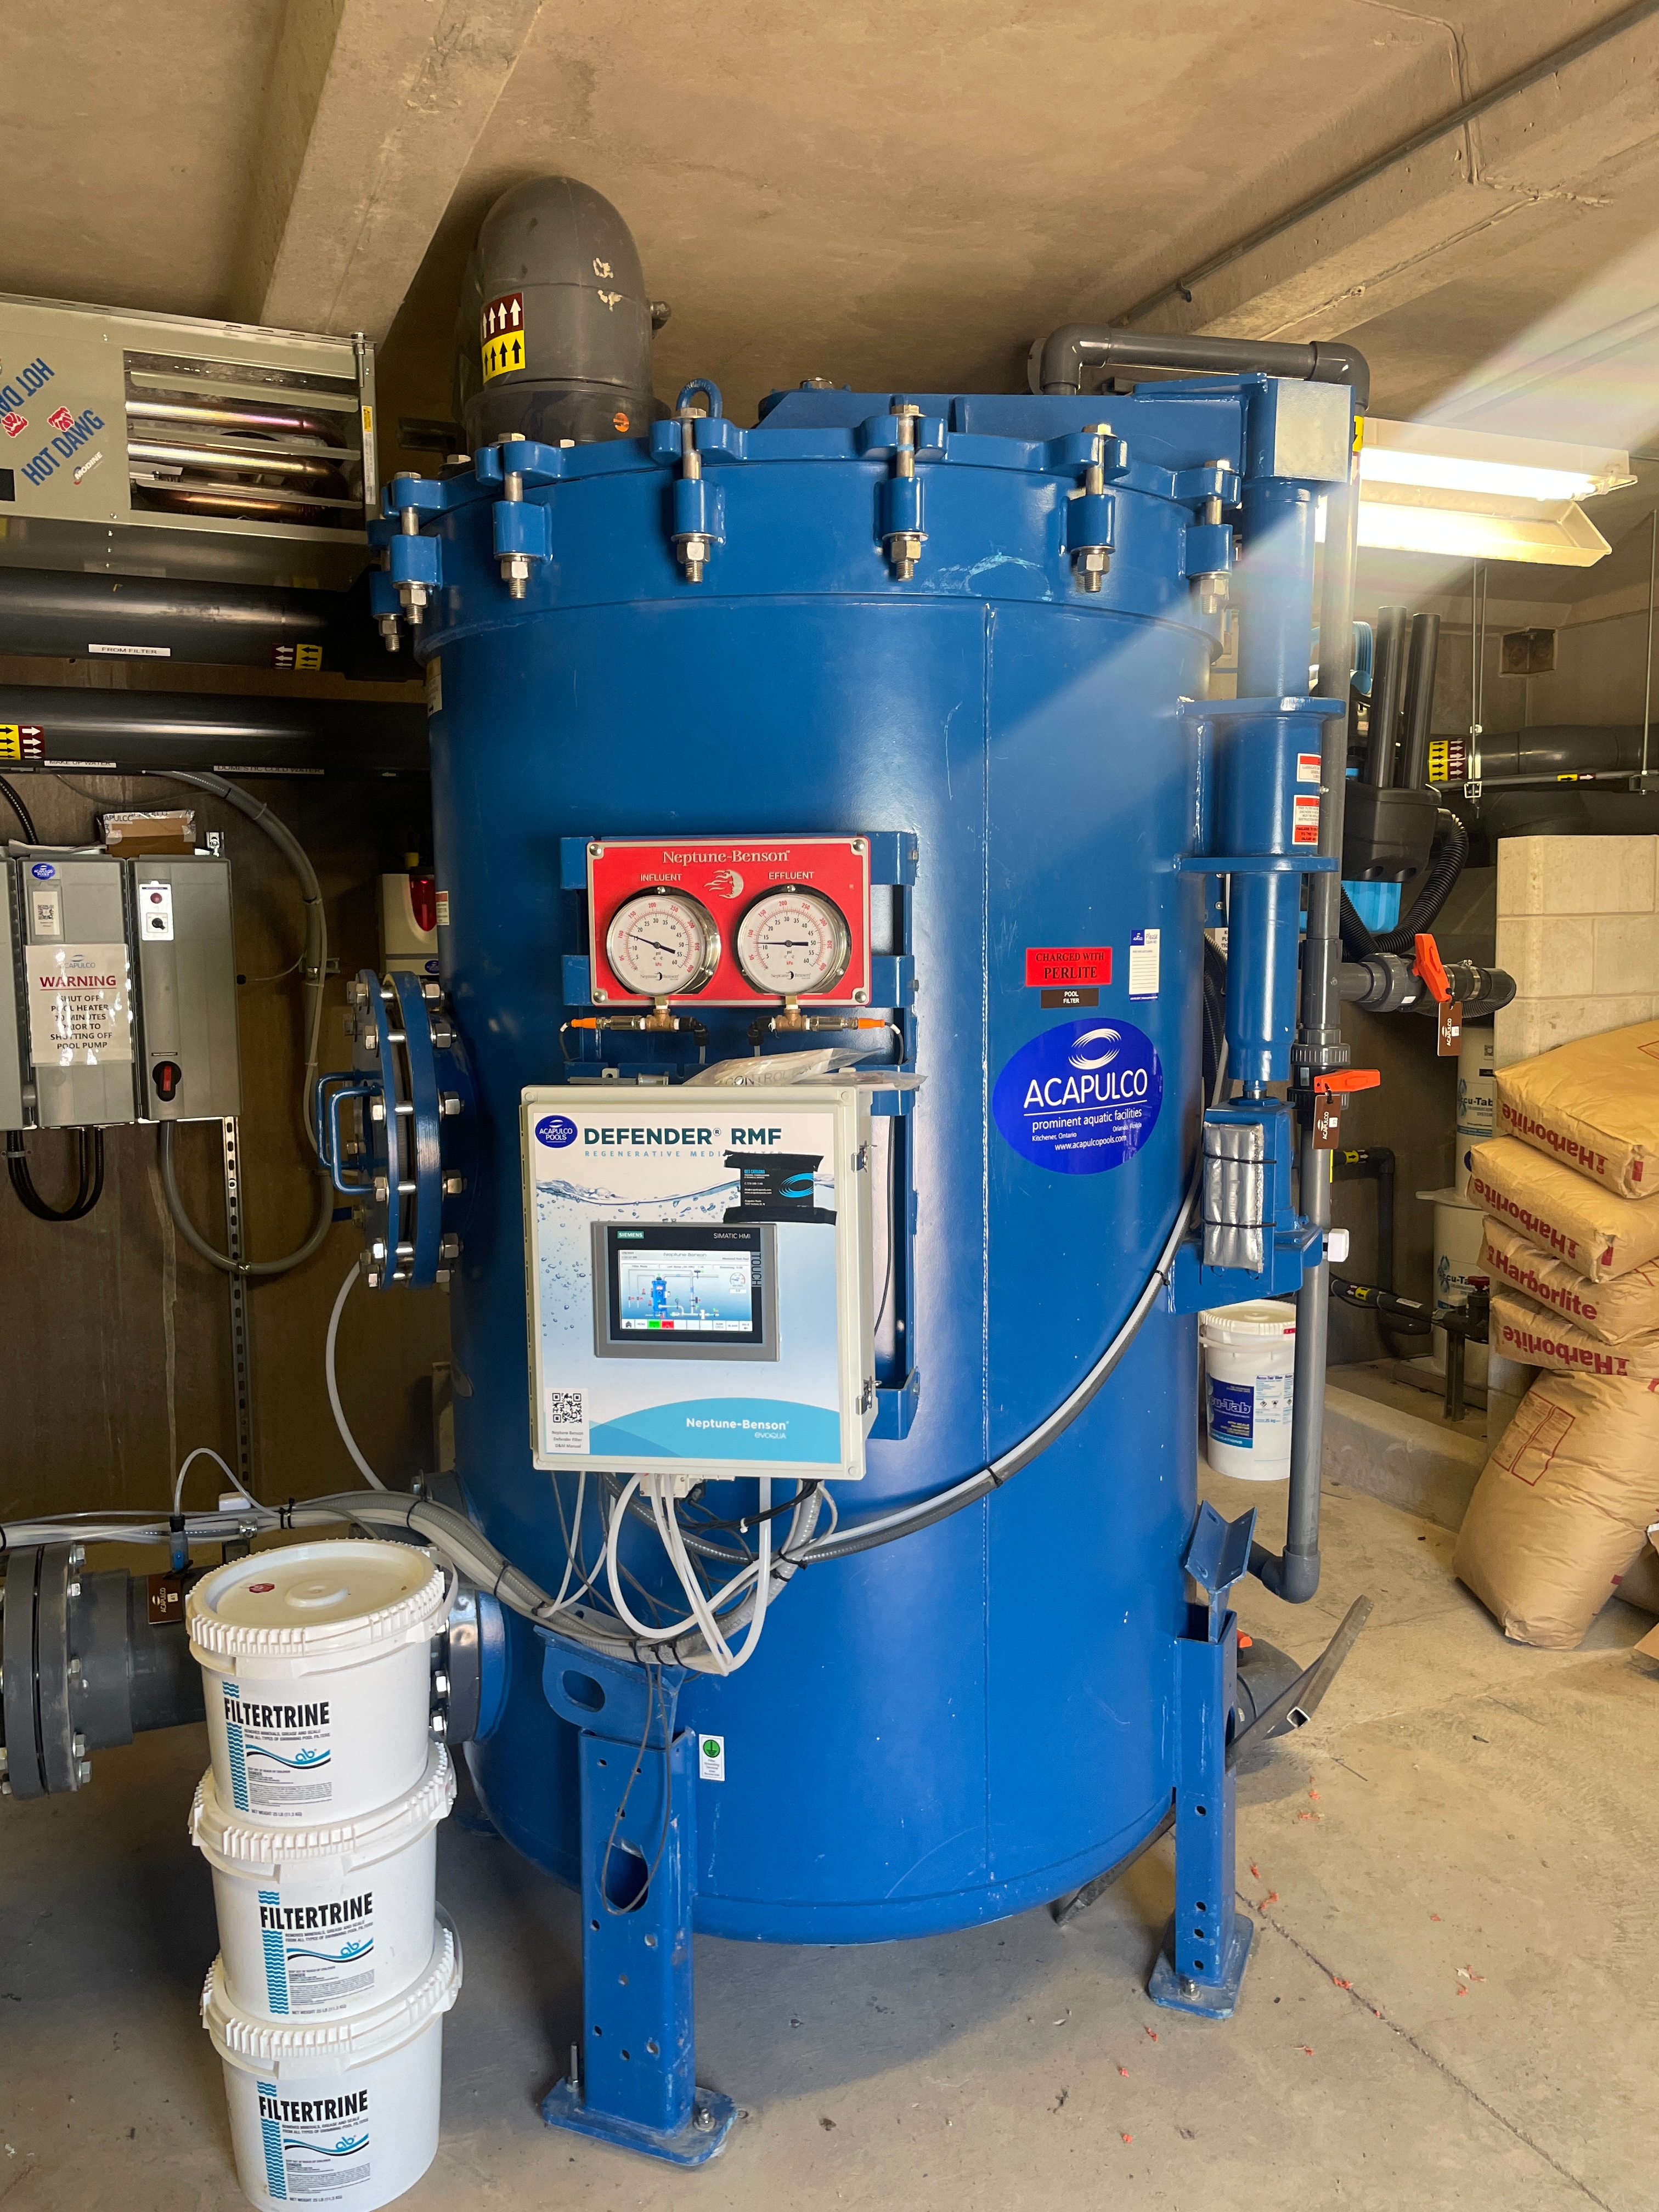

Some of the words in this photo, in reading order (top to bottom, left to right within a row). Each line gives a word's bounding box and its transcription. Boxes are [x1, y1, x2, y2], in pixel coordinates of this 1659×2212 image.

[15, 358, 55, 397] HOT
[21, 447, 60, 486] HOT
[51, 409, 105, 459] DAWG
[74, 452, 103, 479] MODINE
[640, 873, 682, 882] INFLUENT
[768, 871, 815, 880] EFFLUENT
[1036, 952, 1080, 962] CHARGED
[1083, 952, 1104, 961] WITH
[1044, 966, 1097, 979] PERLITE
[40, 975, 116, 988] WARNING
[1023, 1068, 1148, 1108] ACAPULCO
[731, 1128, 782, 1145] RMF
[1032, 1116, 1082, 1133] prominent
[1084, 1112, 1113, 1127] aquatic
[1114, 1107, 1142, 1121] facilities
[1058, 1131, 1077, 1139] Ontario
[1054, 1134, 1127, 1150] www.acapulcopools.com
[1502, 1103, 1594, 1171] Harborlite
[1474, 1178, 1565, 1254] Harborlite
[751, 1253, 762, 1286] TOUCH
[1496, 1250, 1598, 1320] Harborlite
[1503, 1325, 1613, 1375] Harborlite
[224, 1696, 330, 1729] FILTERTRINE
[259, 1892, 373, 1929] FILTERTRINE
[258, 2089, 368, 2122] FILTERTRINE
